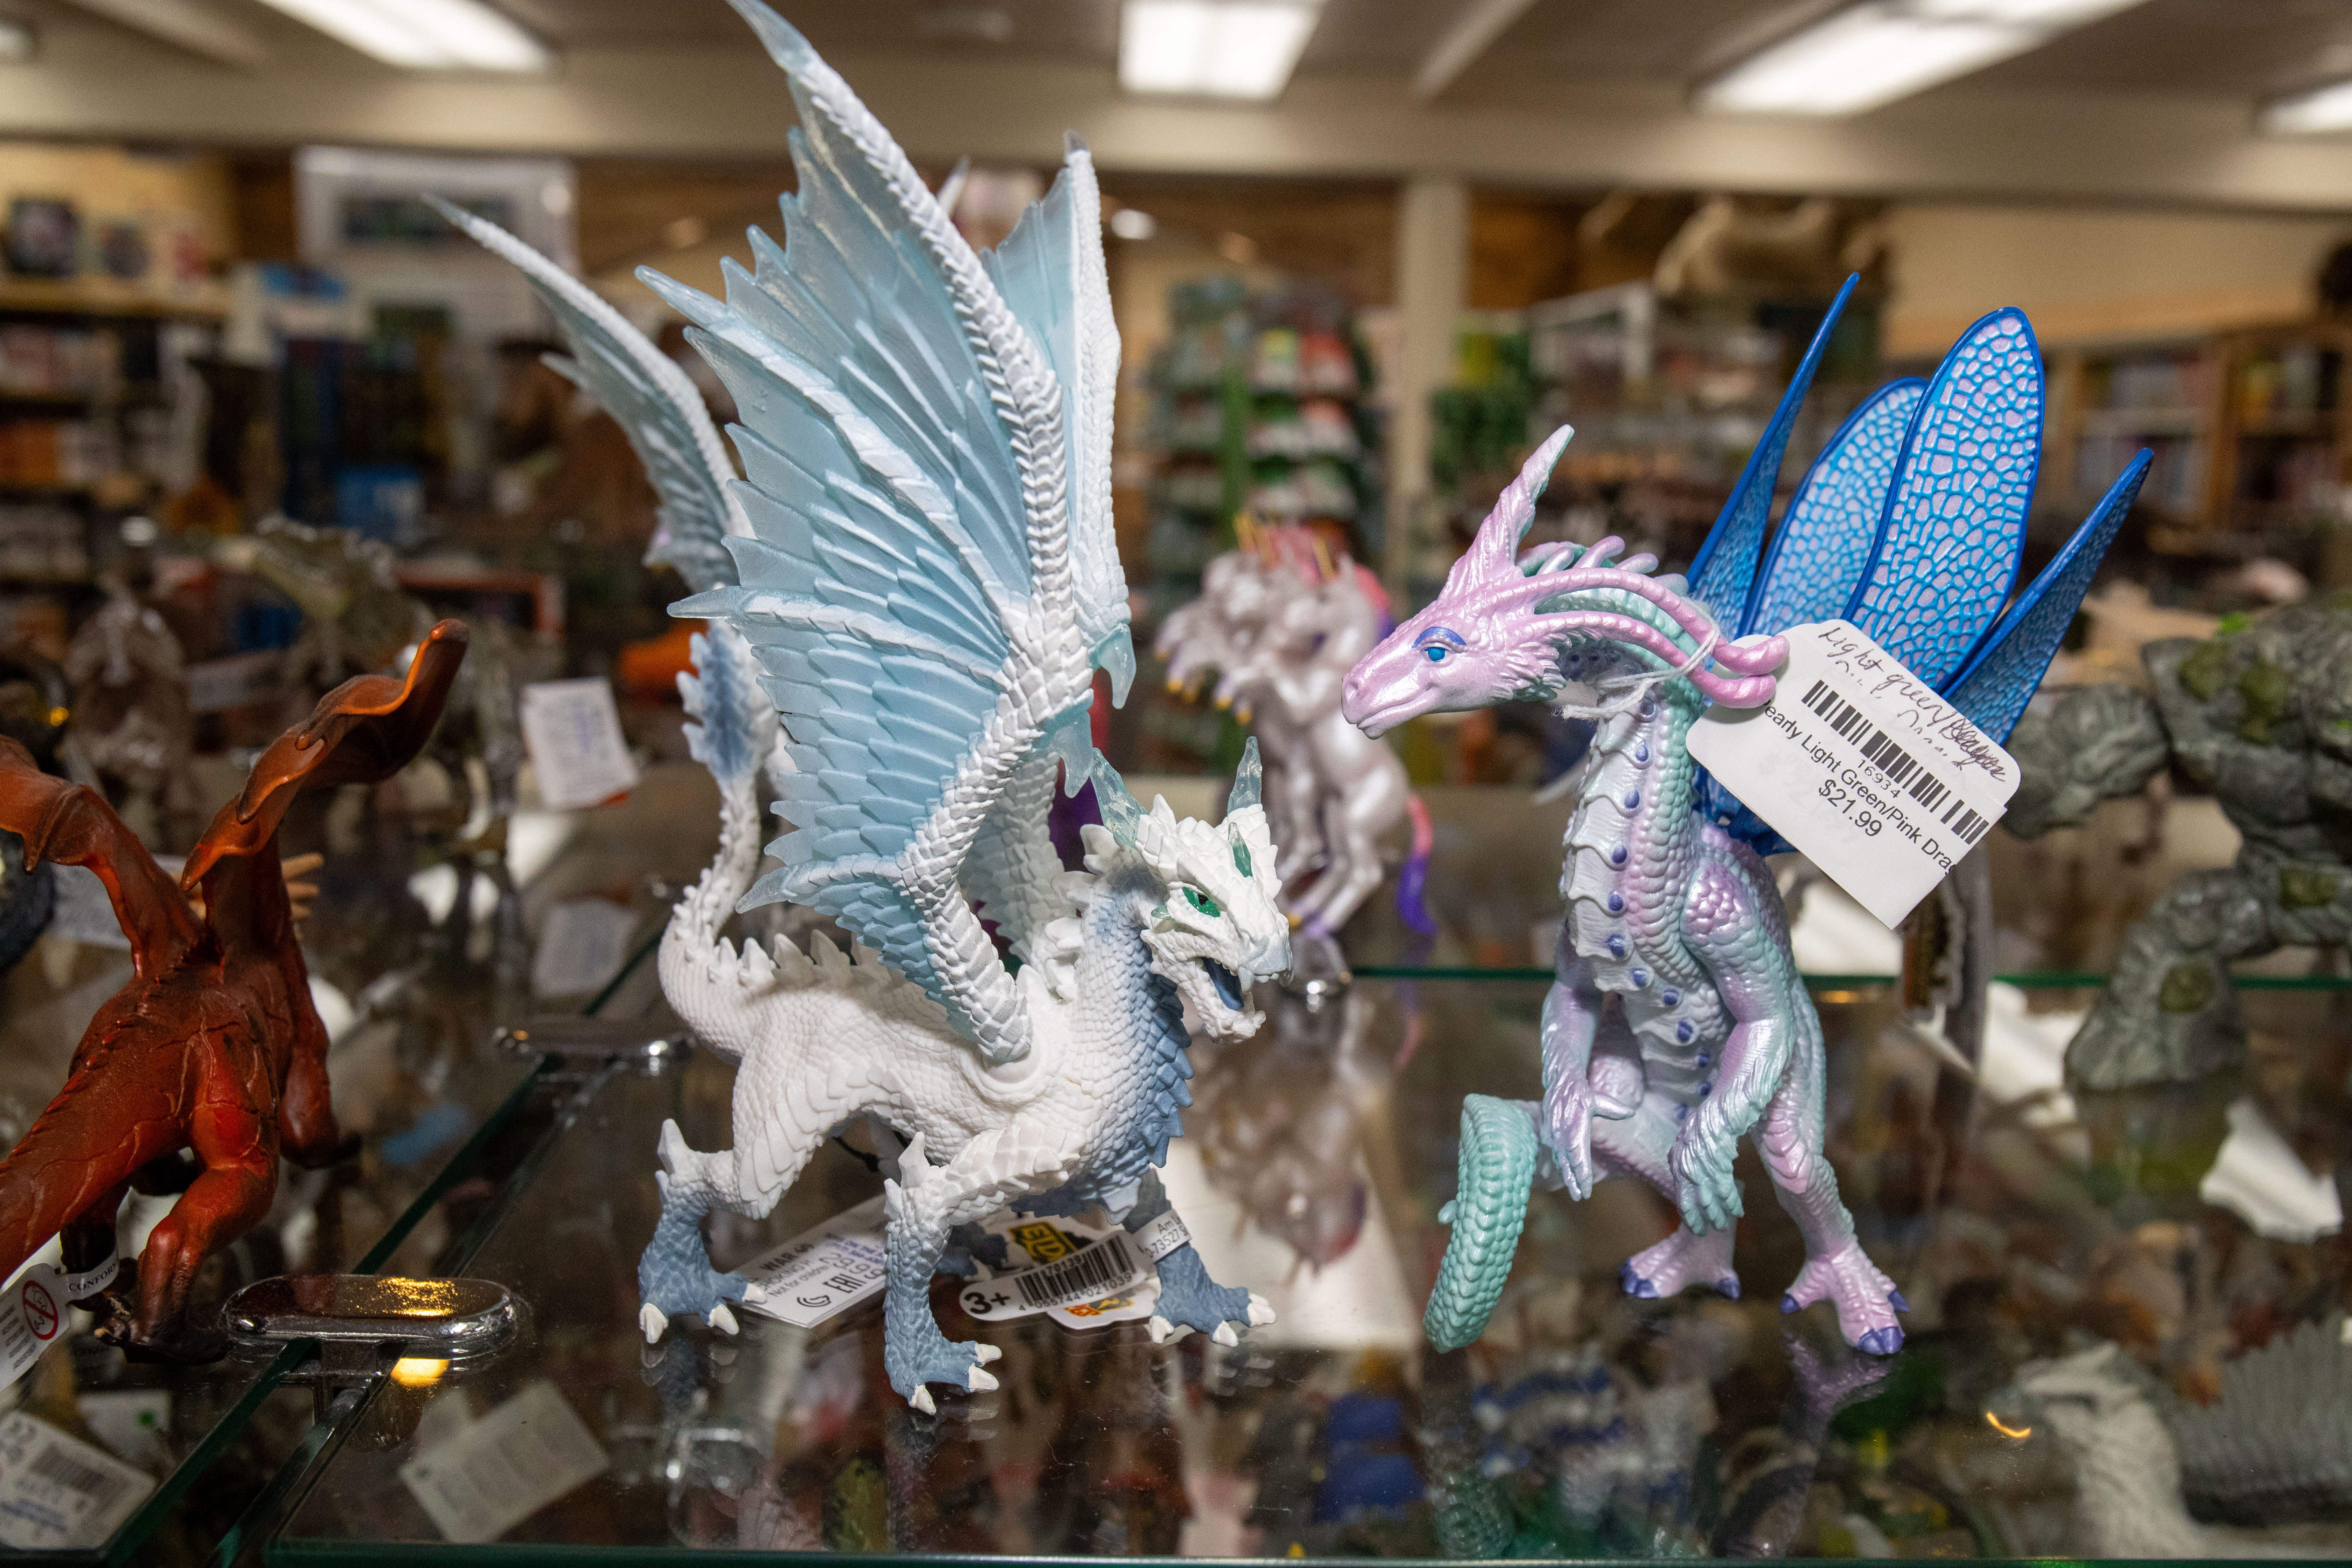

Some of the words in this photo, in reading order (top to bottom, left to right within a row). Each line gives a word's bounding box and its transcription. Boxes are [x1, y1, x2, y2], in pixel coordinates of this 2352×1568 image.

[1818, 627, 1883, 672] Light
[1764, 699, 1802, 739] early
[1801, 734, 1841, 773] Light
[1841, 769, 1922, 843] Green/Pink
[1858, 759, 1901, 798] 16934
[1819, 780, 1882, 836] $21.99
[1158, 1221, 1174, 1234] Am
[69, 1263, 116, 1291] CONFOR
[1047, 1255, 1081, 1276] 70139
[964, 1292, 1010, 1314] 3+
[1035, 1291, 1081, 1308] 055744
[1087, 1272, 1132, 1297] 021039
